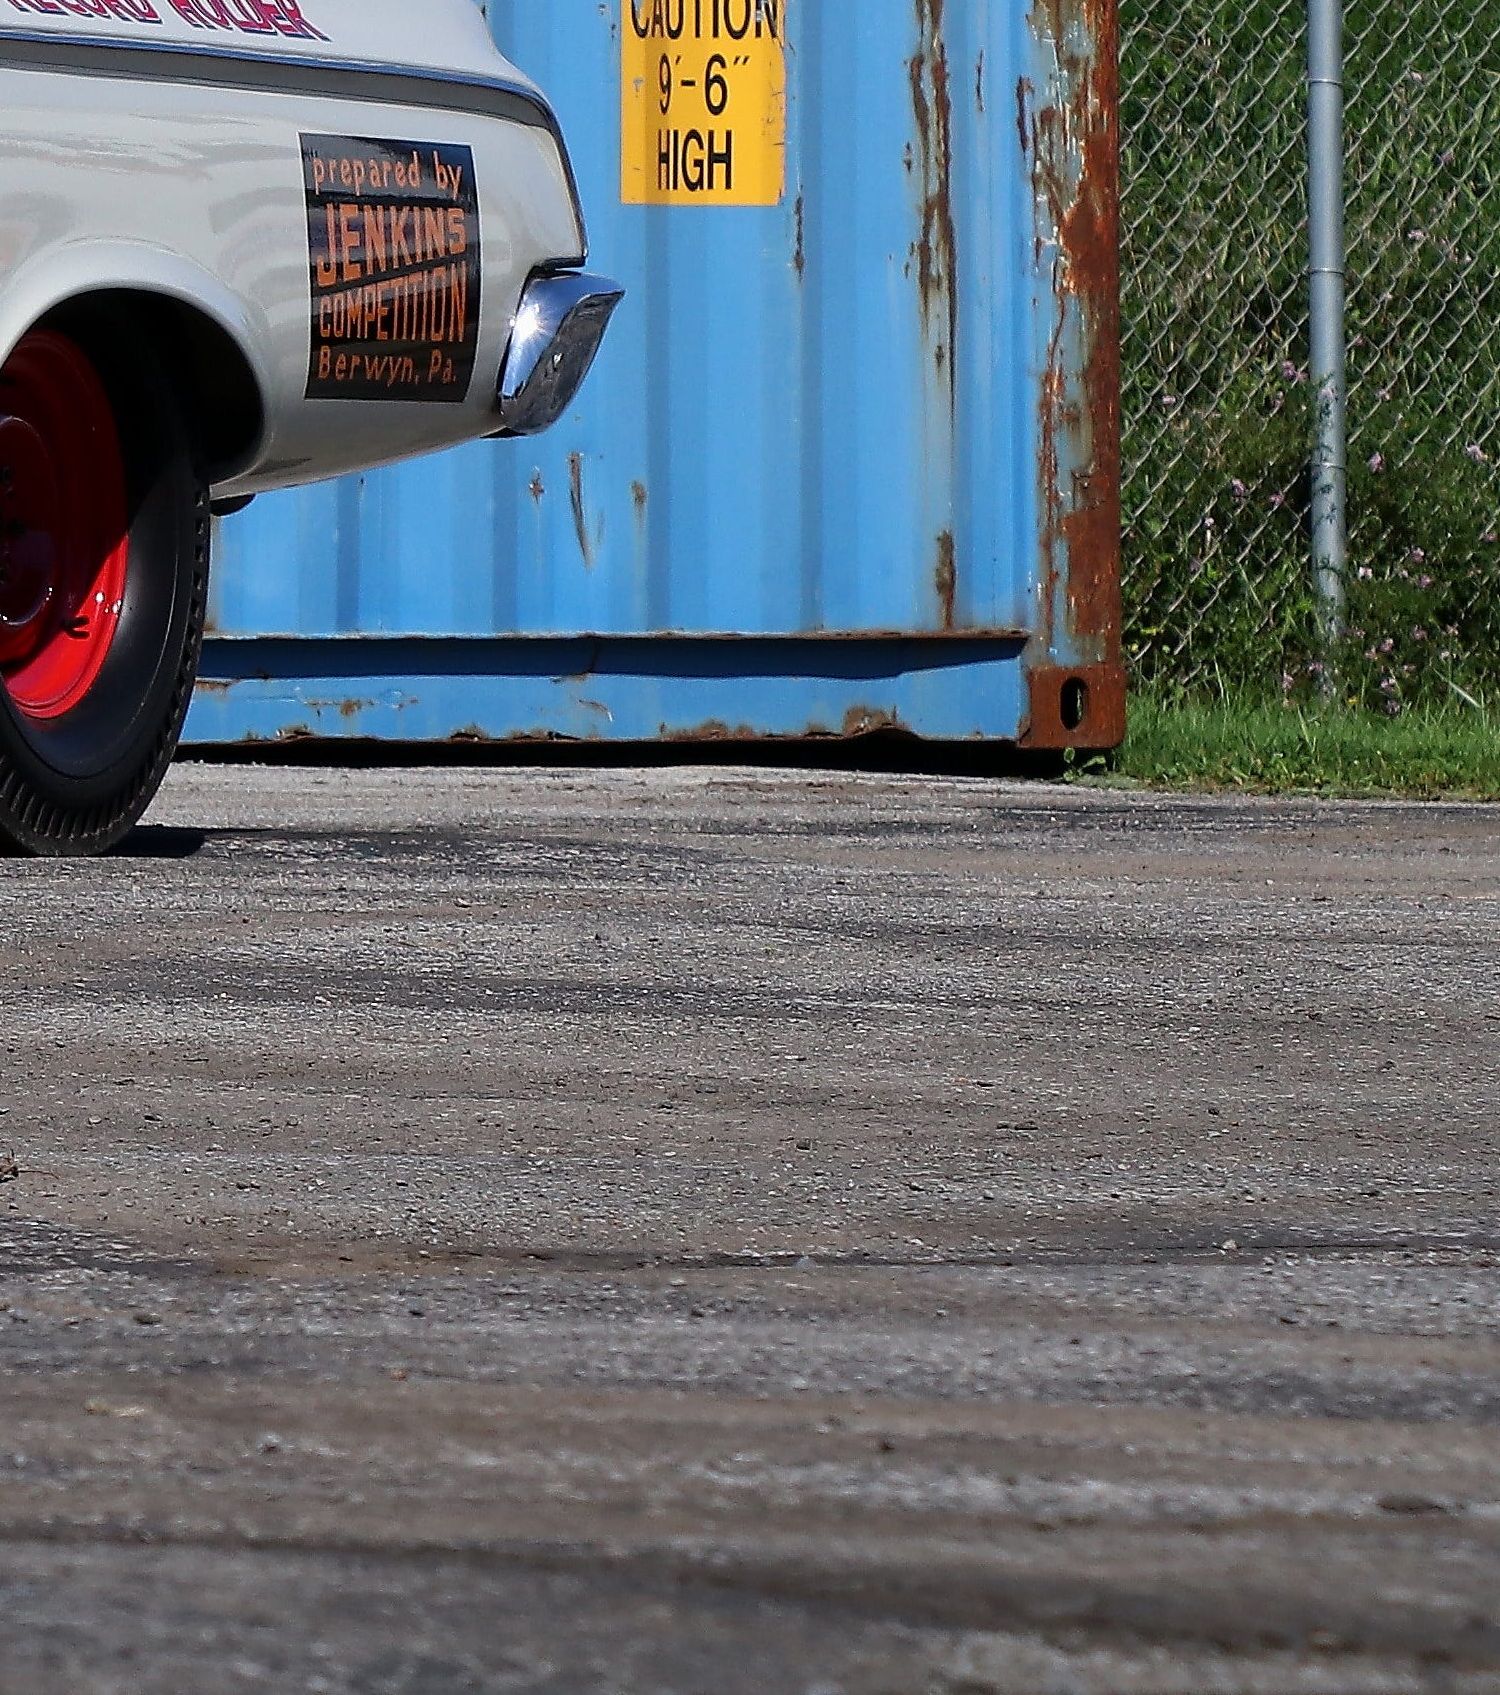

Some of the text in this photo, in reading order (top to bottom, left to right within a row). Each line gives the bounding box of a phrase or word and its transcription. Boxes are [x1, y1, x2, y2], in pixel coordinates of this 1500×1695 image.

[311, 150, 463, 200] prepared by
[658, 128, 732, 192] HIGH
[315, 201, 467, 289] JENKINS
[318, 260, 467, 343] COMPETITION
[427, 348, 458, 385] Pa.
